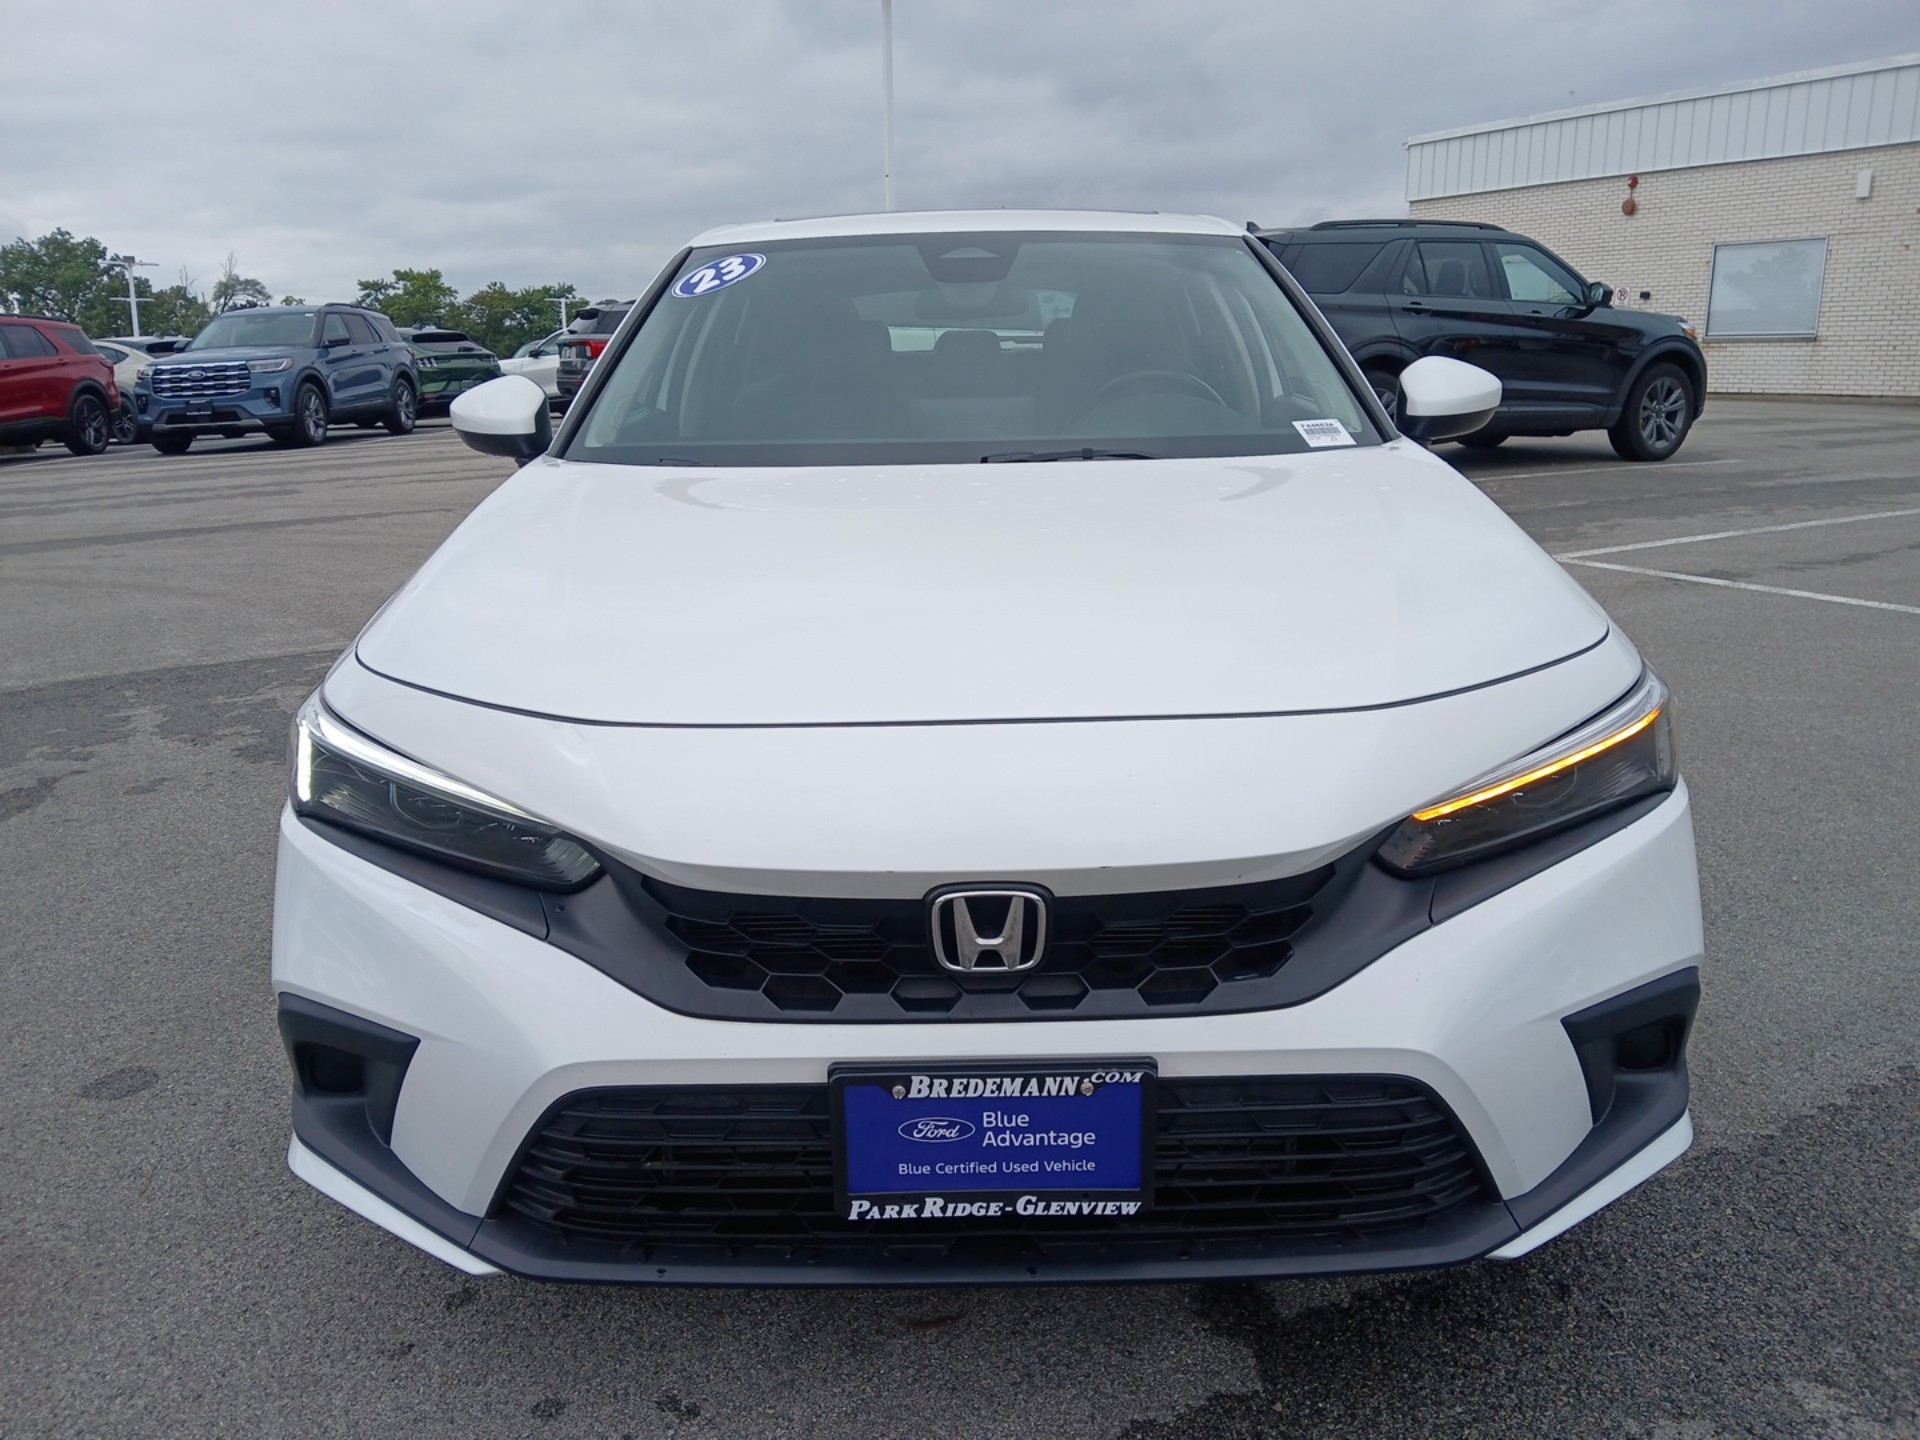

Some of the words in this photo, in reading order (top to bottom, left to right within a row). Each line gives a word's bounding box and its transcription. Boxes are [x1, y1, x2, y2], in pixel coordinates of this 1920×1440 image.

[689, 257, 746, 293] 23
[912, 1119, 961, 1139] Ford
[982, 1111, 1030, 1128] Blue
[982, 1129, 1097, 1150] Advantage
[898, 1162, 932, 1175] Blue
[935, 1161, 998, 1175] Certified
[1002, 1161, 1040, 1173] Used
[1043, 1158, 1097, 1173] Vehicle
